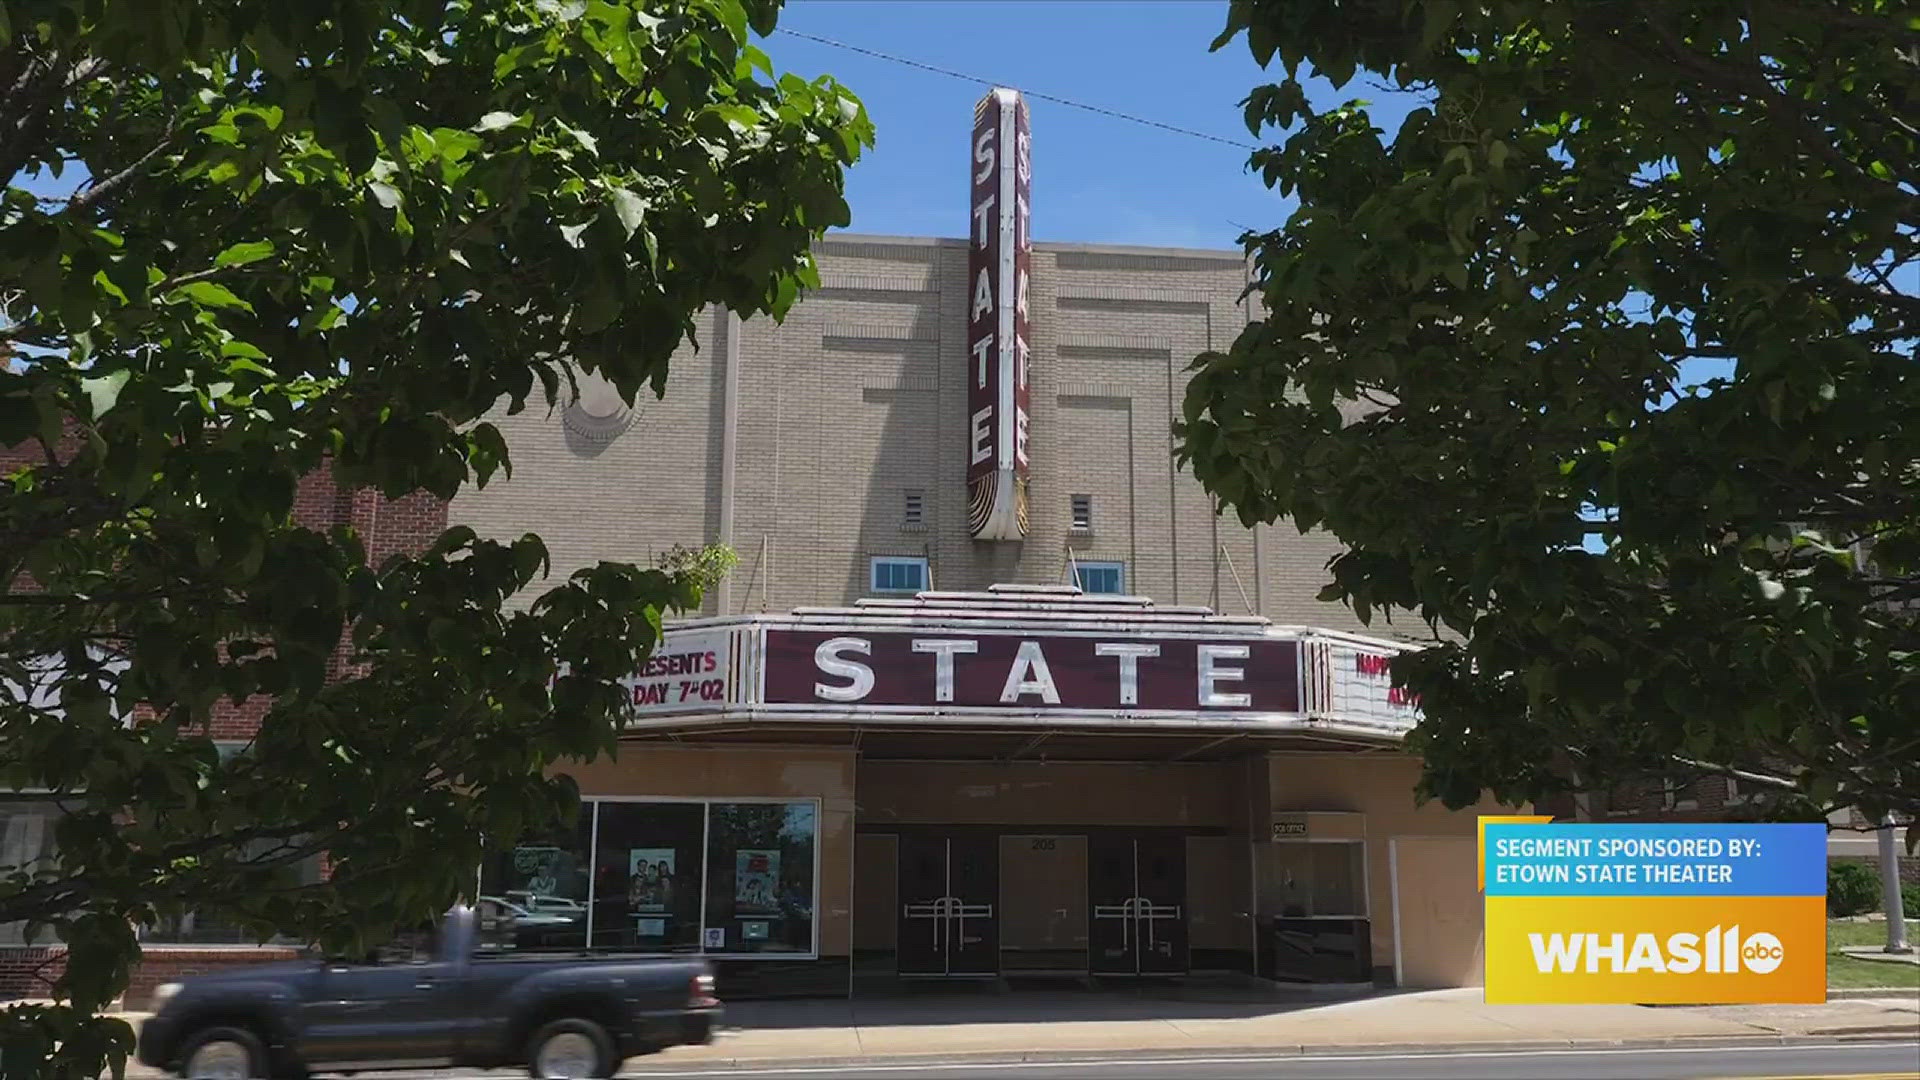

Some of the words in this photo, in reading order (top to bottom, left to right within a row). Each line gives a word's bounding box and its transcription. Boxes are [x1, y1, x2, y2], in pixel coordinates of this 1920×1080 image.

[973, 127, 996, 467] STATE
[1016, 131, 1032, 467] STATE
[633, 682, 670, 705] DAY
[813, 636, 1252, 706] STATE
[1032, 839, 1056, 851] 205
